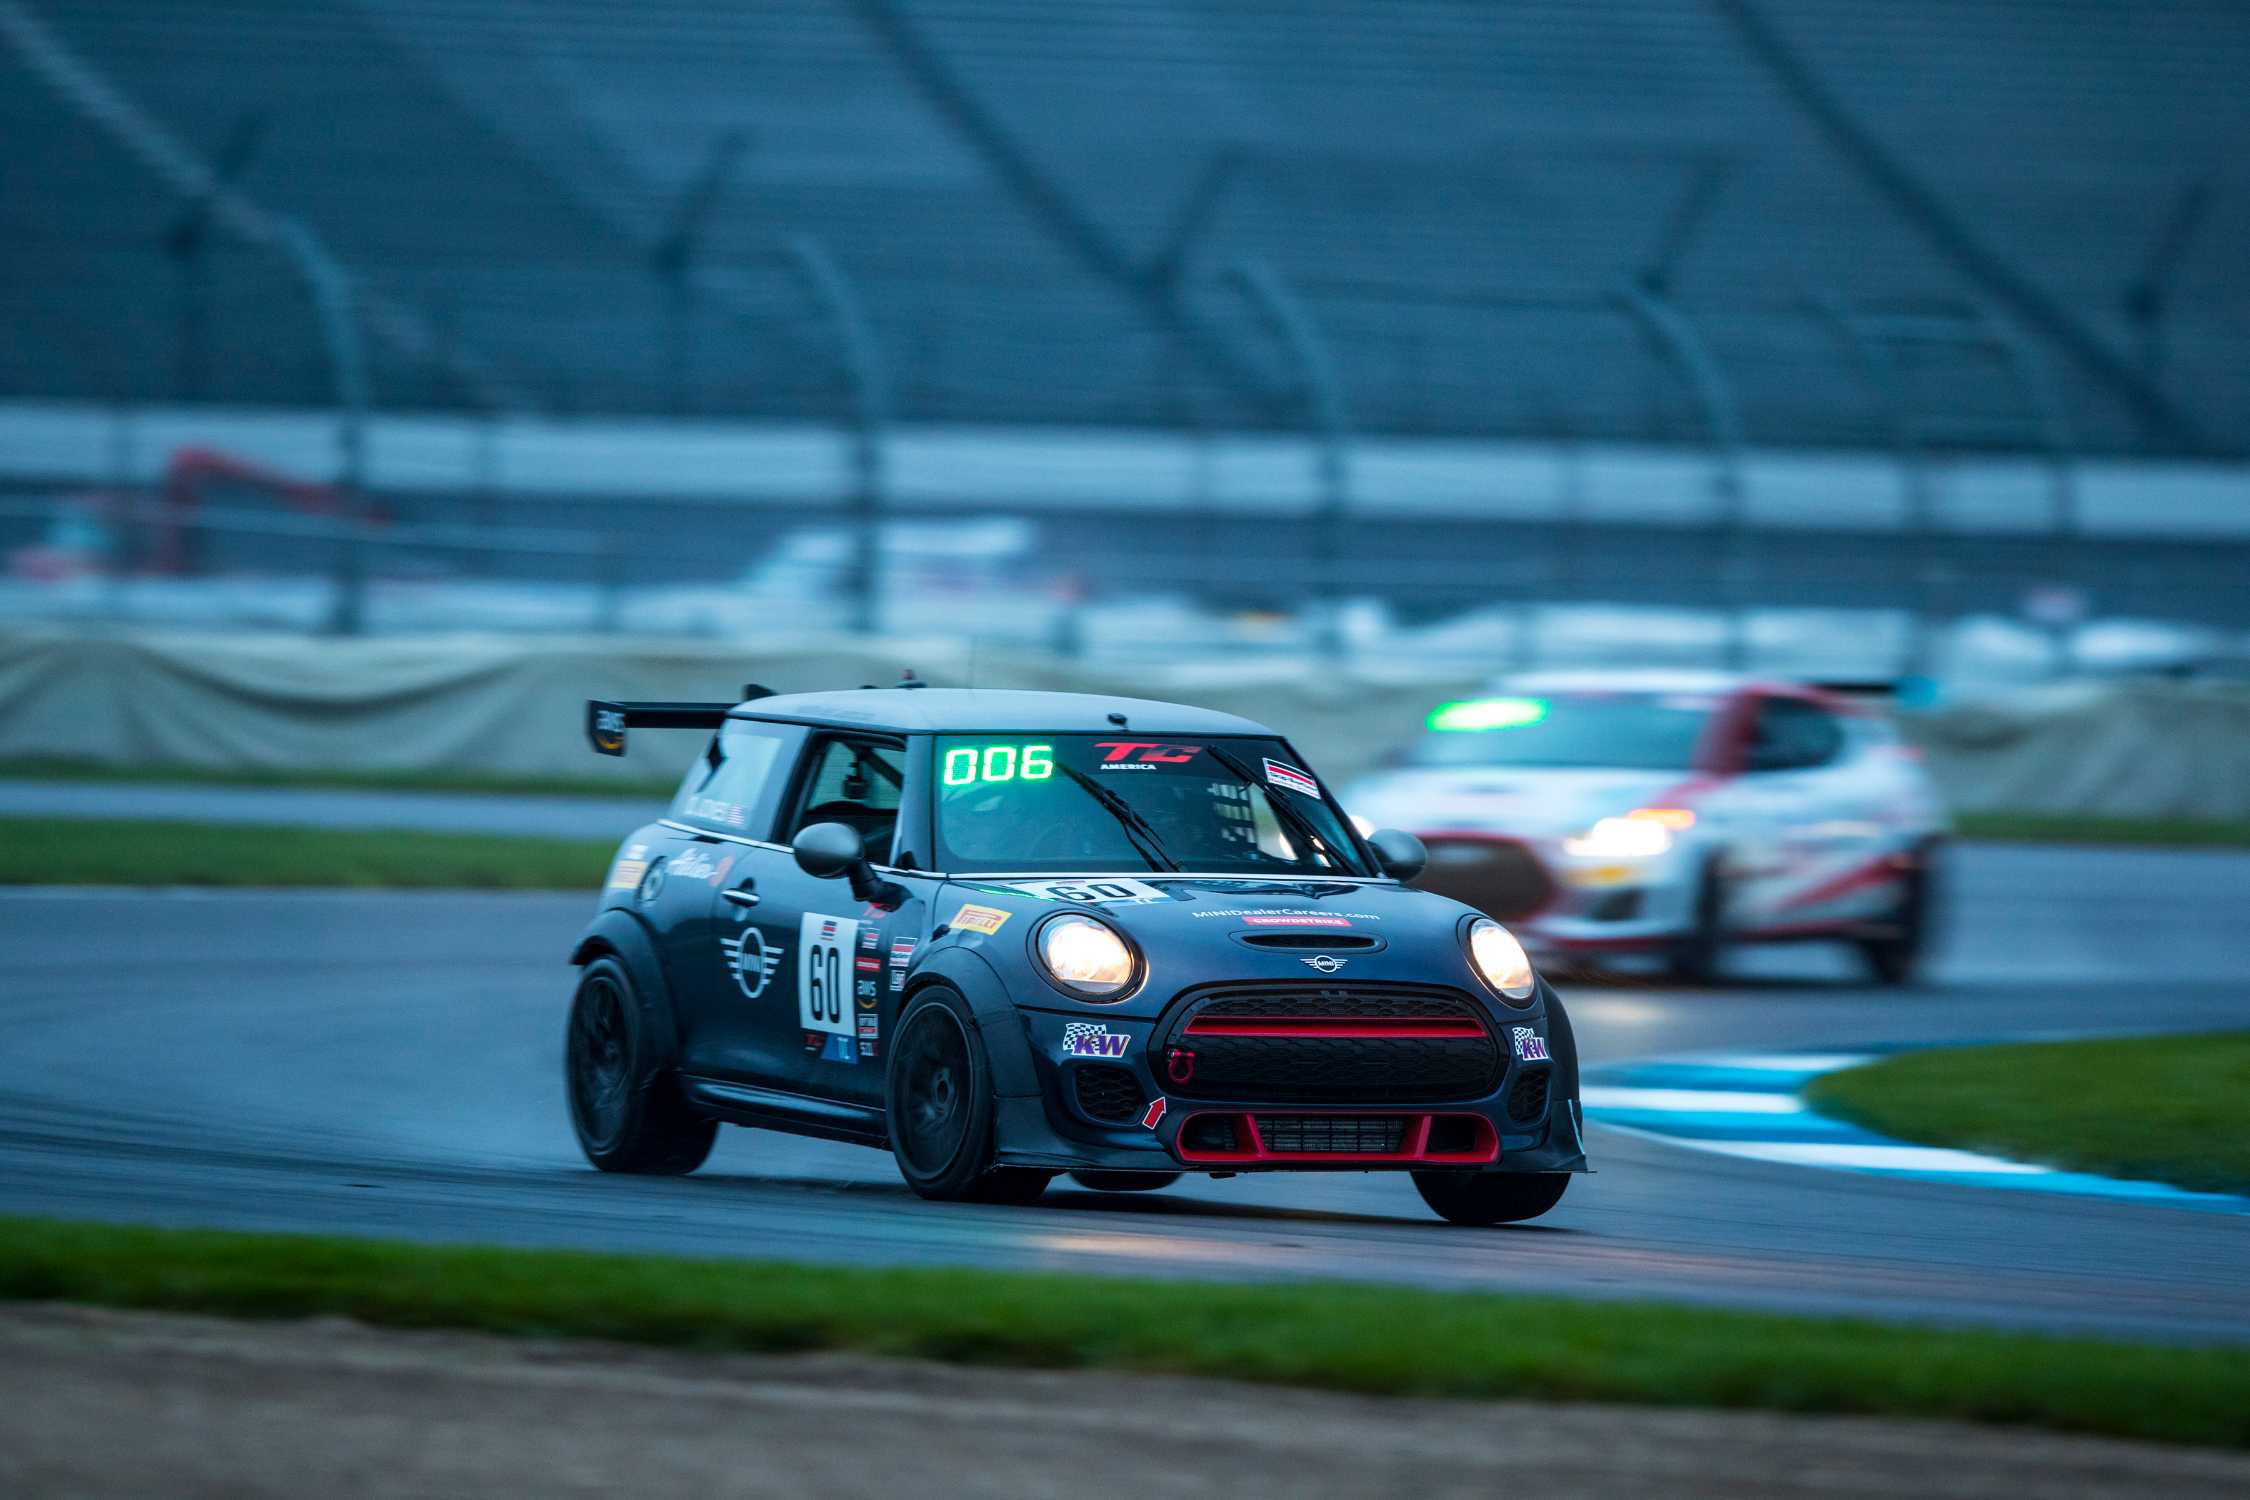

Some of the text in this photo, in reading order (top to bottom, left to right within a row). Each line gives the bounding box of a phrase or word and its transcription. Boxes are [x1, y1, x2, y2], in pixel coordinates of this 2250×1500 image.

[943, 745, 1054, 785] 006
[1094, 742, 1201, 763] TC
[1045, 883, 1137, 901] 60
[810, 944, 840, 1024] 60
